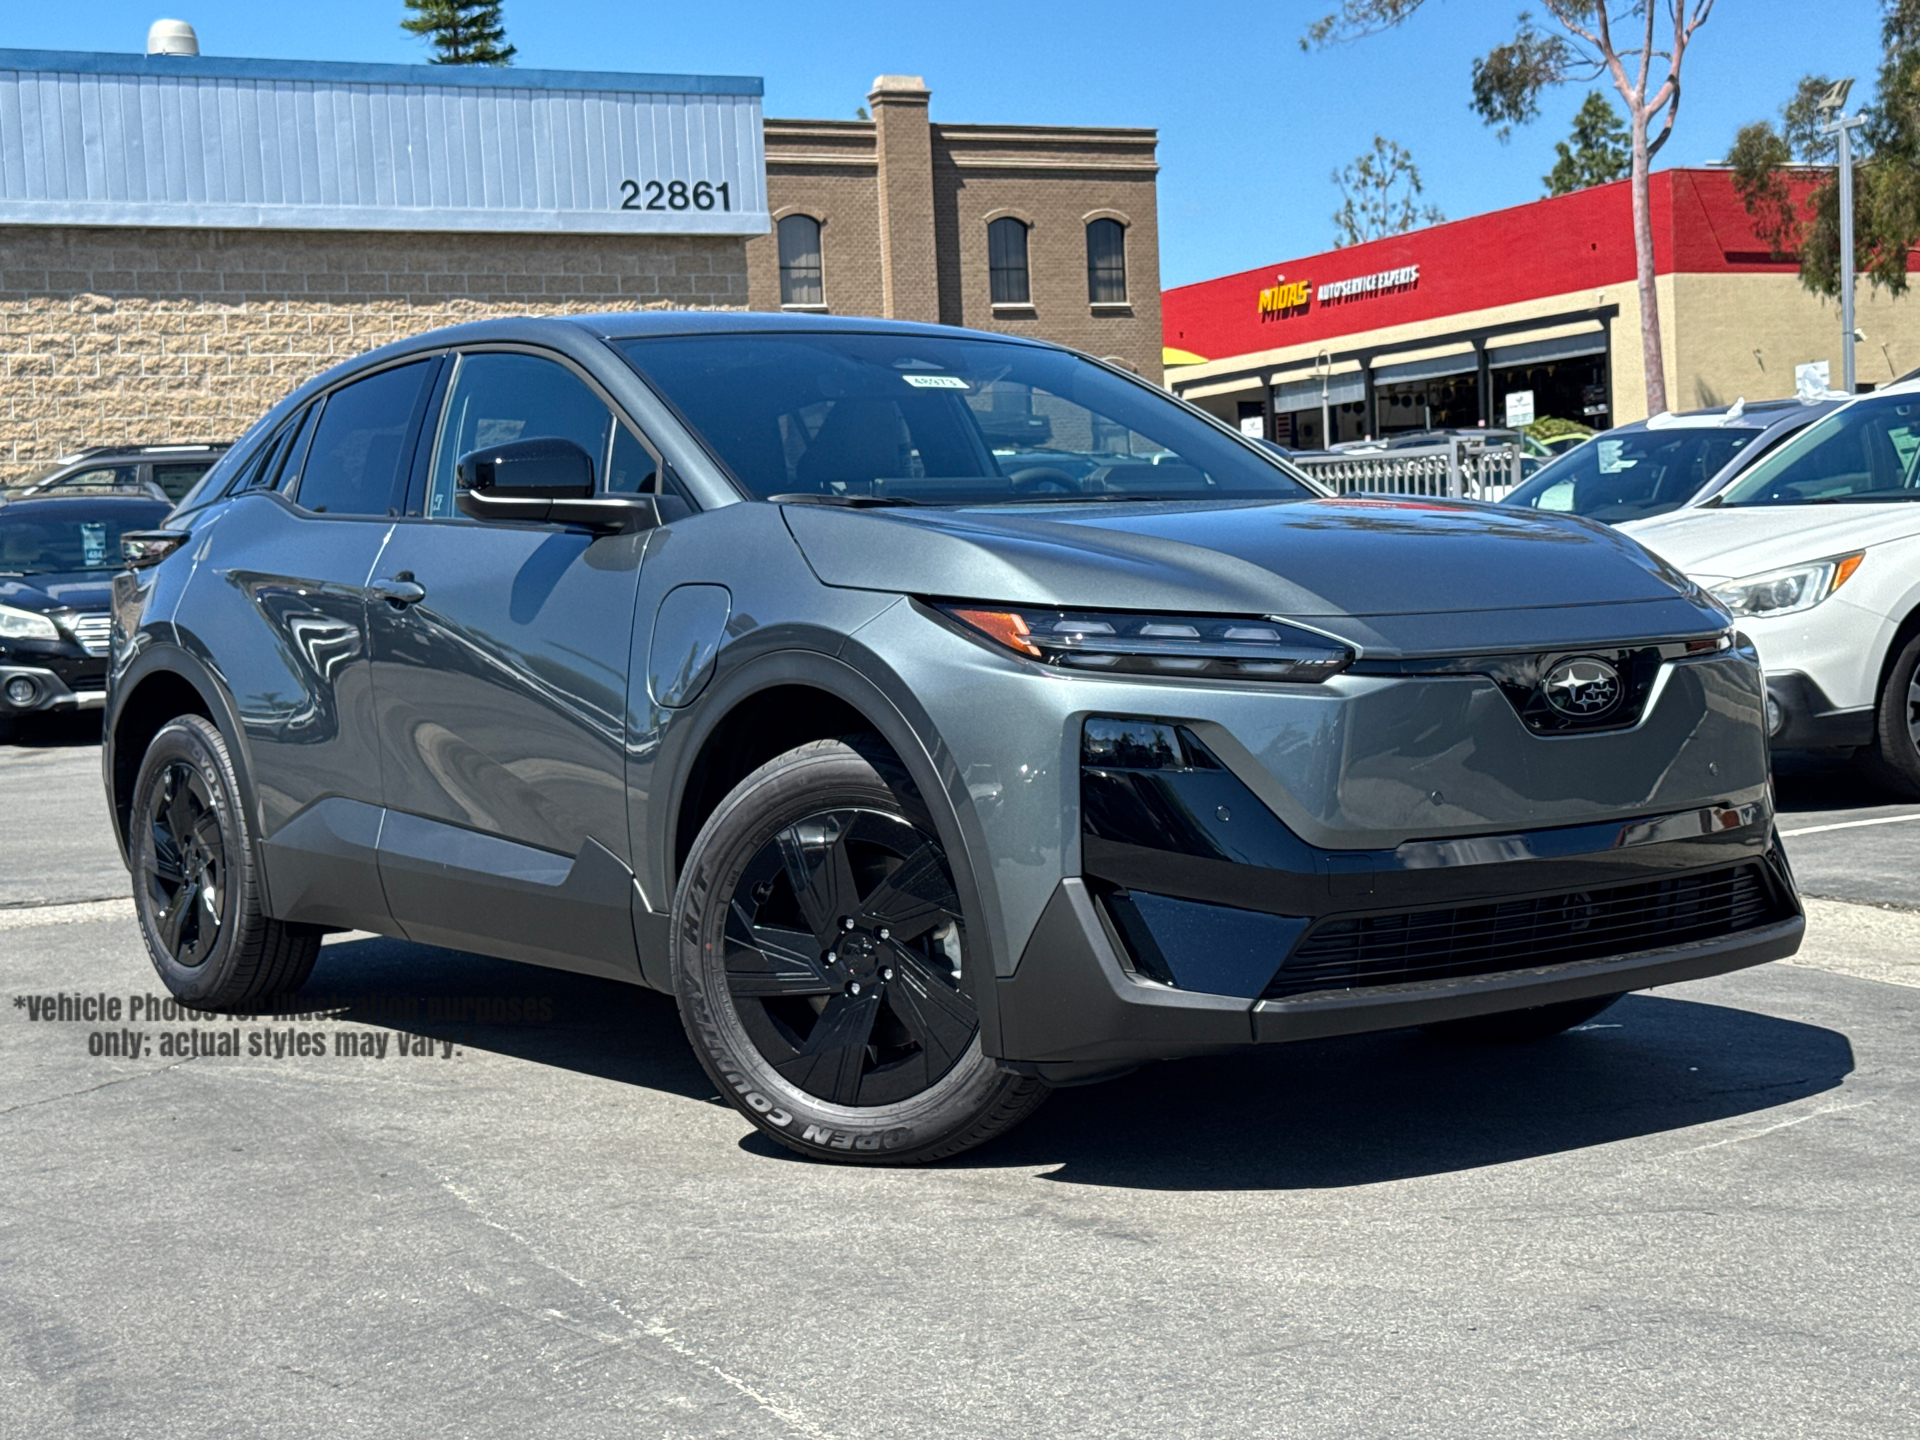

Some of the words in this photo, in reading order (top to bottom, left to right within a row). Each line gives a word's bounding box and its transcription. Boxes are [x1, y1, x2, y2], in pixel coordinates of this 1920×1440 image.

[620, 180, 730, 211] 22861
[1258, 280, 1309, 313] MIDAS
[1317, 281, 1341, 301] AUTO
[683, 866, 710, 947] H/T
[683, 981, 794, 1127] COUNTRY
[802, 1124, 915, 1150] OPEN
